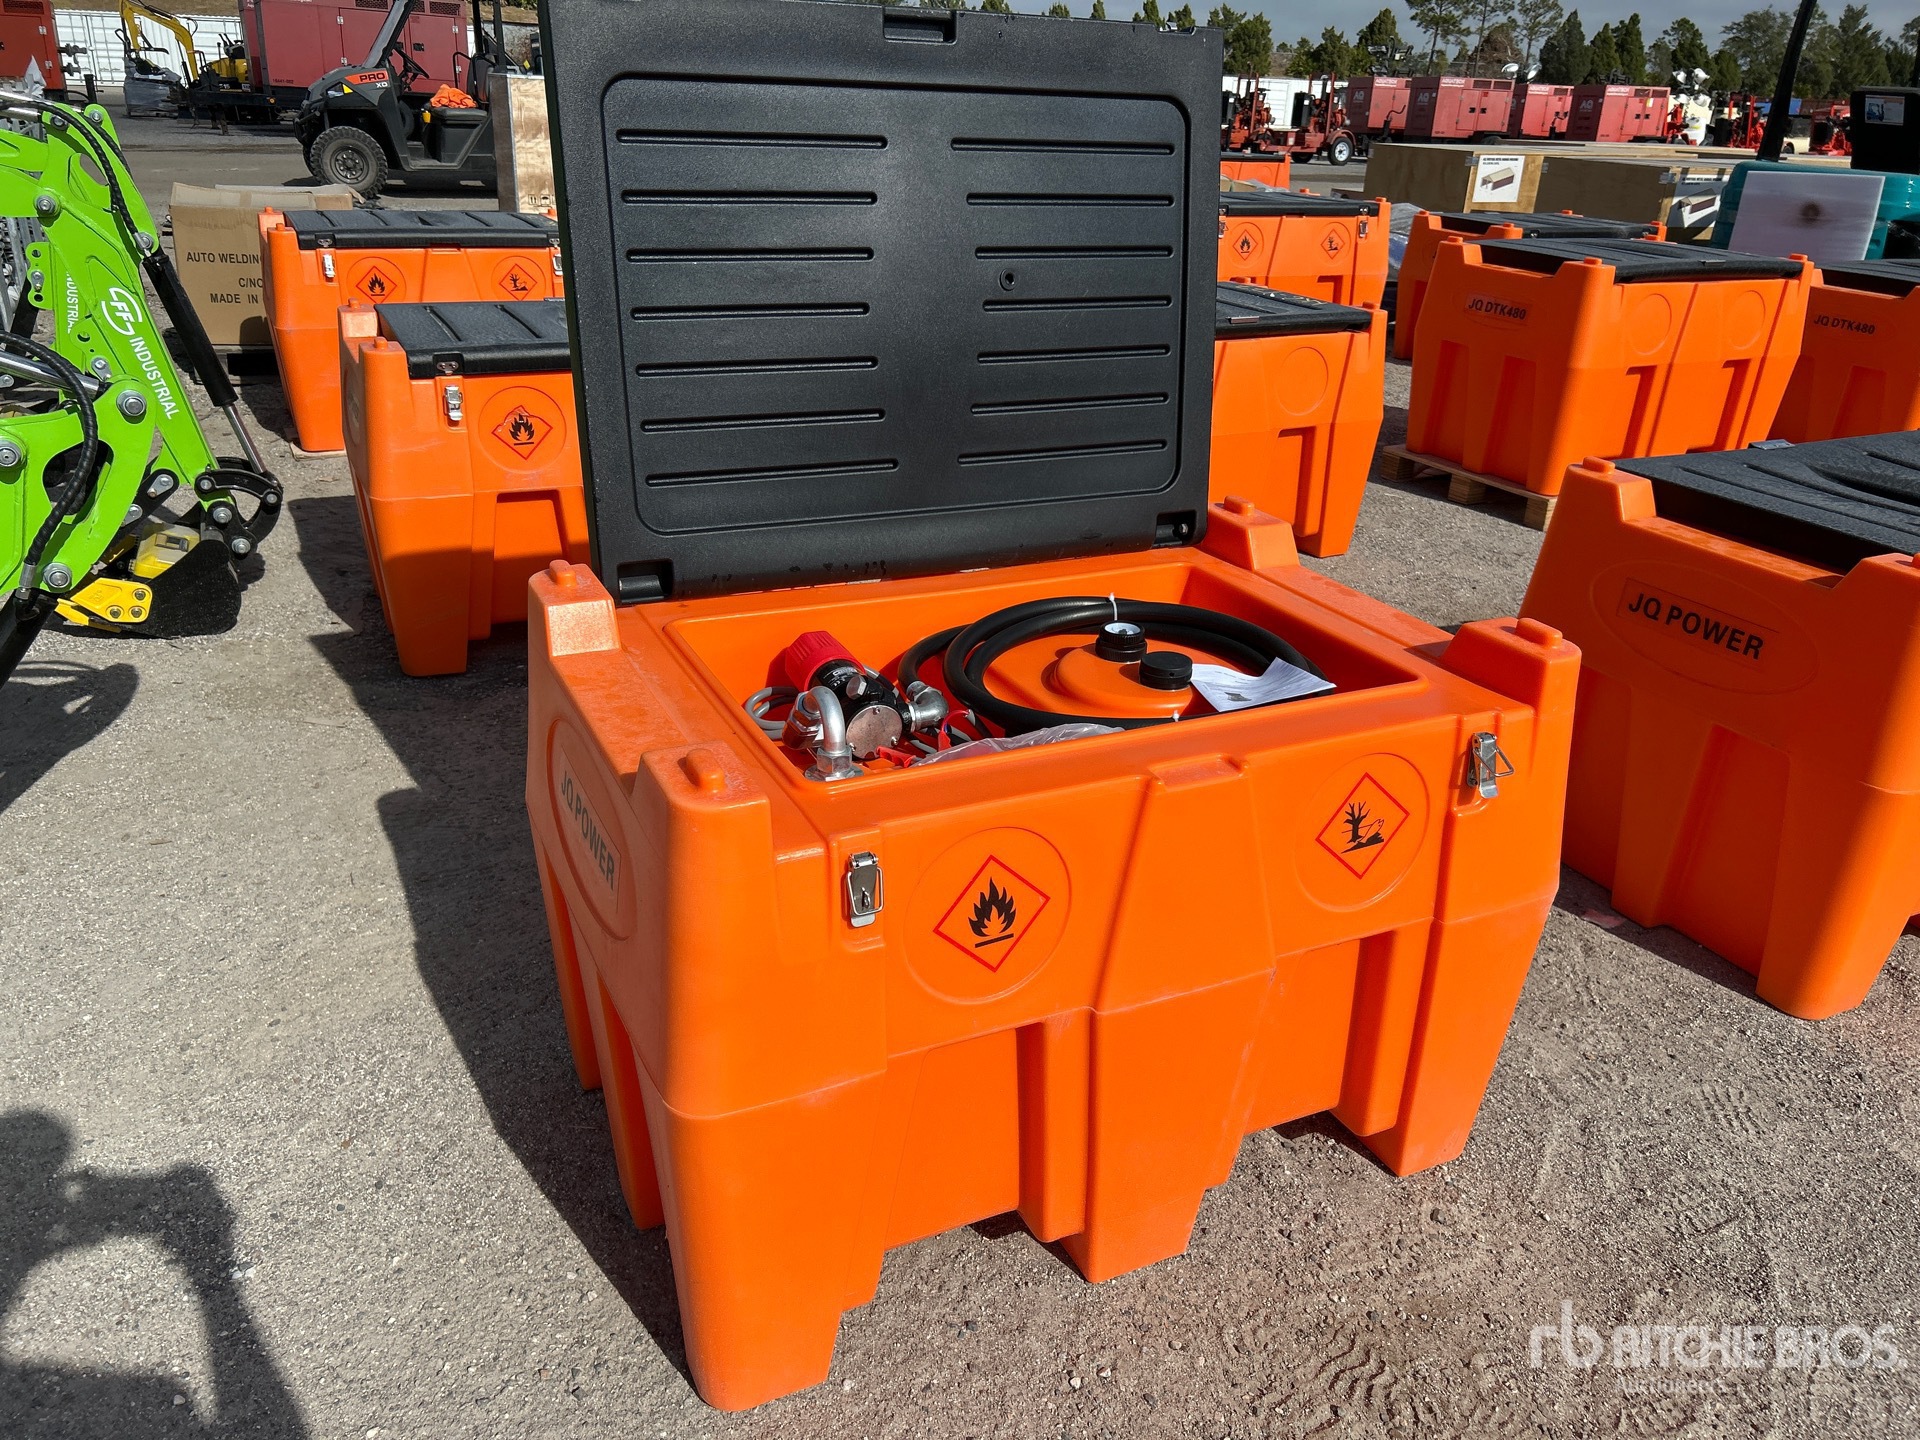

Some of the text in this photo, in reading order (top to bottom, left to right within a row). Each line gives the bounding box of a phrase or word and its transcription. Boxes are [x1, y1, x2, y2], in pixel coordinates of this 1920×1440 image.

[359, 72, 386, 82] PRO
[186, 252, 261, 265] AUTO WELDIN
[210, 293, 258, 304] MADE IN
[1468, 299, 1527, 320] JQ DTK480
[1814, 314, 1876, 334] JQ DTK480
[129, 336, 180, 420] INDUSTRIAL
[1628, 593, 1764, 660] JQ POWER
[561, 771, 615, 892] JQ POWER
